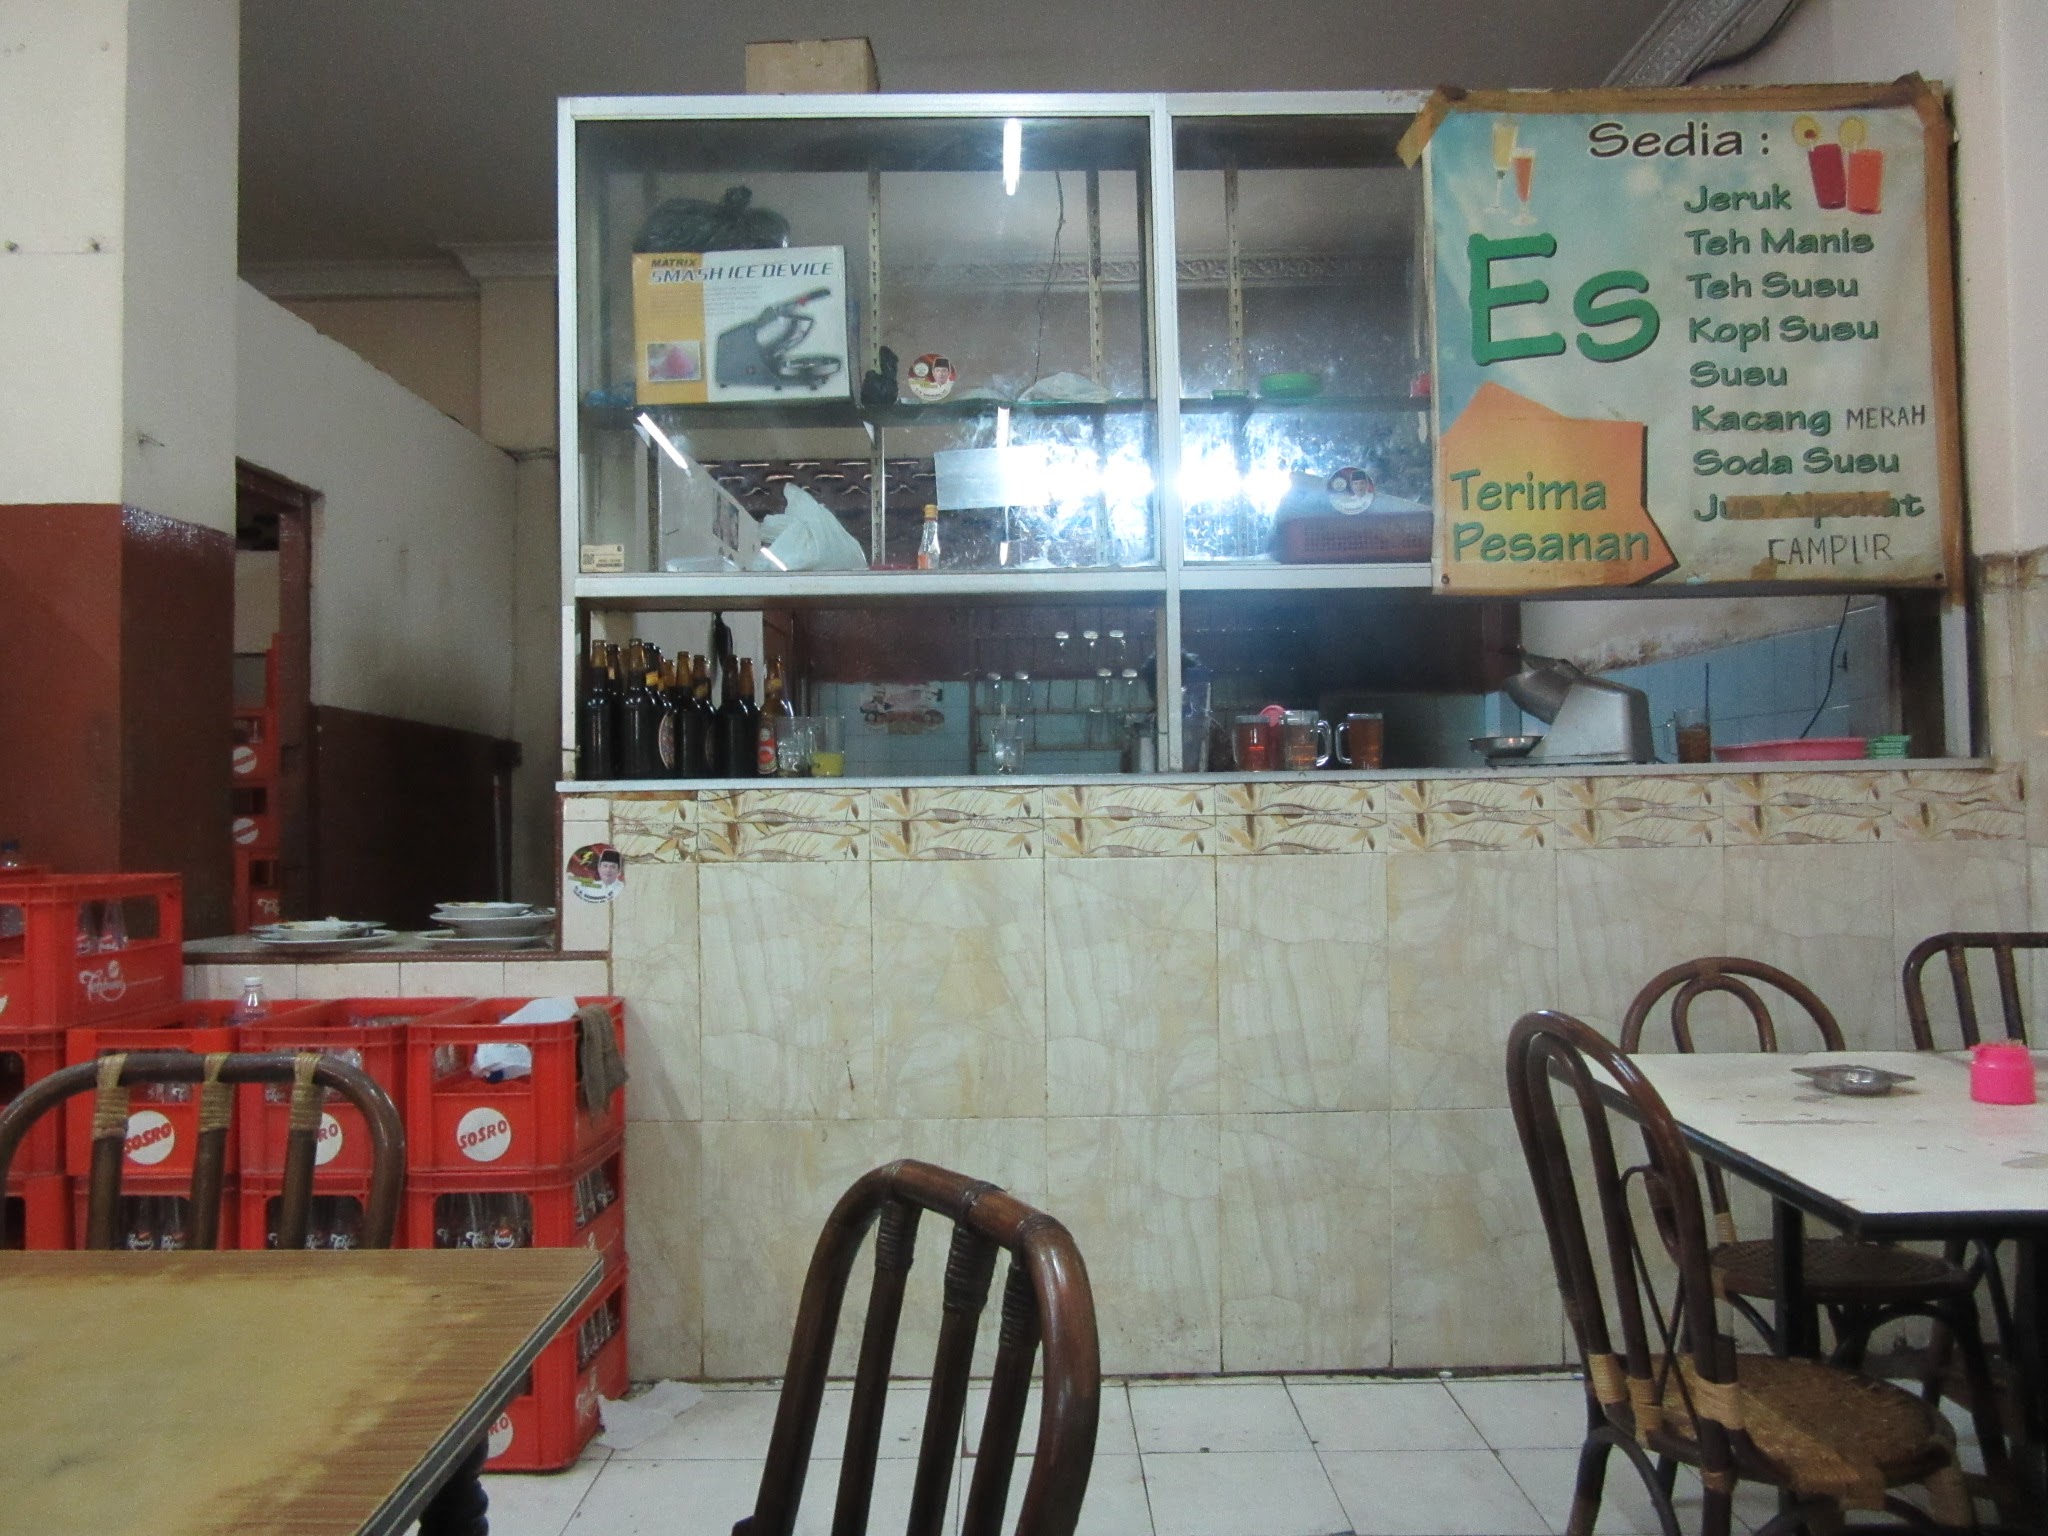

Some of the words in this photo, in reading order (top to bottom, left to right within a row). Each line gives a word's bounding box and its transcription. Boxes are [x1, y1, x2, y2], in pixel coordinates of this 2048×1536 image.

[1589, 121, 1743, 158] Sedia
[1683, 183, 1792, 213] Jeruk
[1684, 228, 1750, 255] Teh
[1760, 227, 1875, 254] Manis
[651, 258, 698, 268] MATRIX
[651, 266, 723, 283] SMASH
[728, 264, 757, 279] ICE
[762, 262, 833, 278] DEVICE
[1467, 233, 1660, 366] Es
[1685, 272, 1751, 299] Teh
[1761, 271, 1859, 298] Susu
[1688, 317, 1770, 352] Kopi
[1779, 315, 1879, 342] Susu
[1689, 360, 1788, 387] Susu
[1691, 405, 1831, 436] Kacang
[1846, 404, 1926, 430] MERAH
[1693, 448, 1793, 476] Soda
[1802, 447, 1900, 474] Susu
[1451, 469, 1606, 511] Terima
[1453, 521, 1649, 562] Pesanan
[1767, 533, 1894, 566] CAMPUR
[459, 1119, 509, 1150] SOSRO
